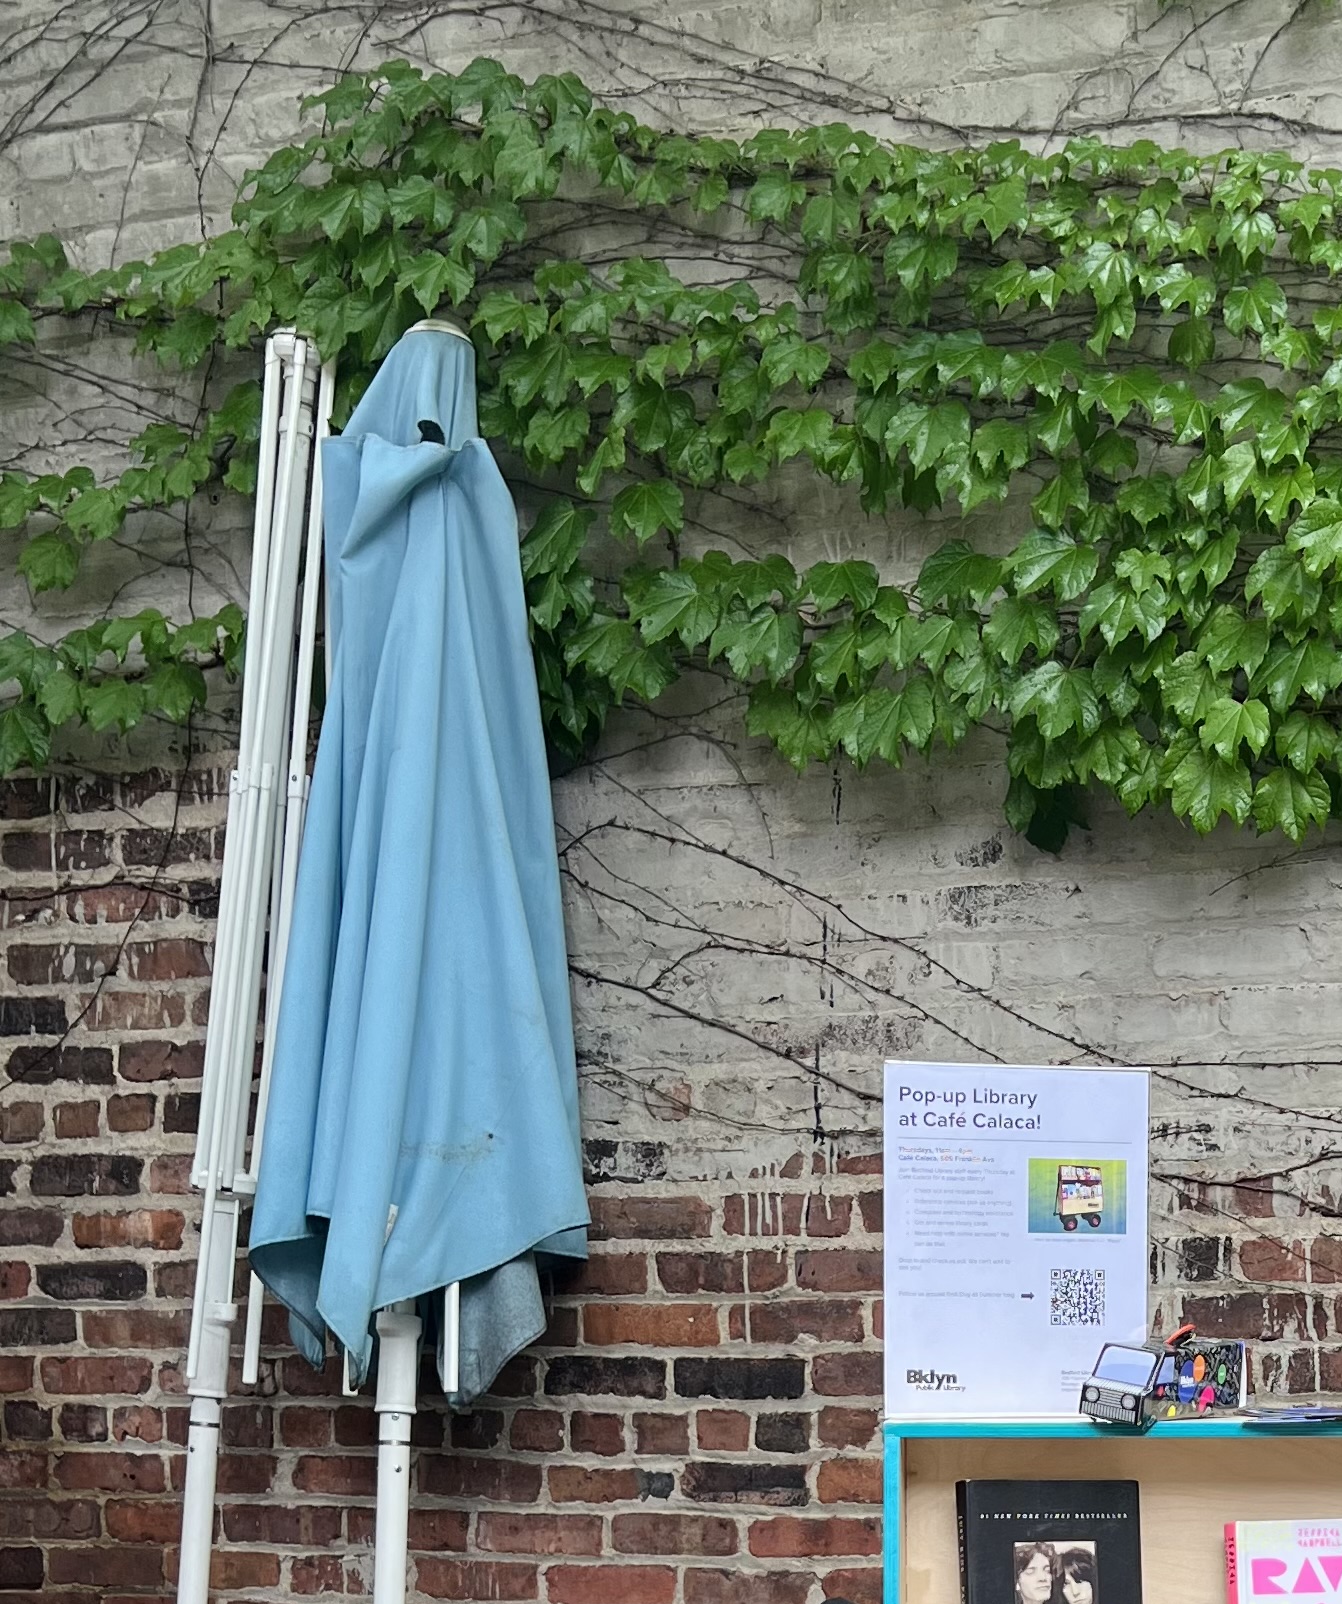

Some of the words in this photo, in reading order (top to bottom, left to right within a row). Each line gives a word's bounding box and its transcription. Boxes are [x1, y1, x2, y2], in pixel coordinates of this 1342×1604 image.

[899, 1086, 967, 1107] Pop-up
[973, 1088, 1038, 1109] Library
[899, 1112, 917, 1126] at
[923, 1112, 967, 1127] Café
[972, 1113, 1041, 1130] Calaca!
[907, 1369, 957, 1390] Bklyn
